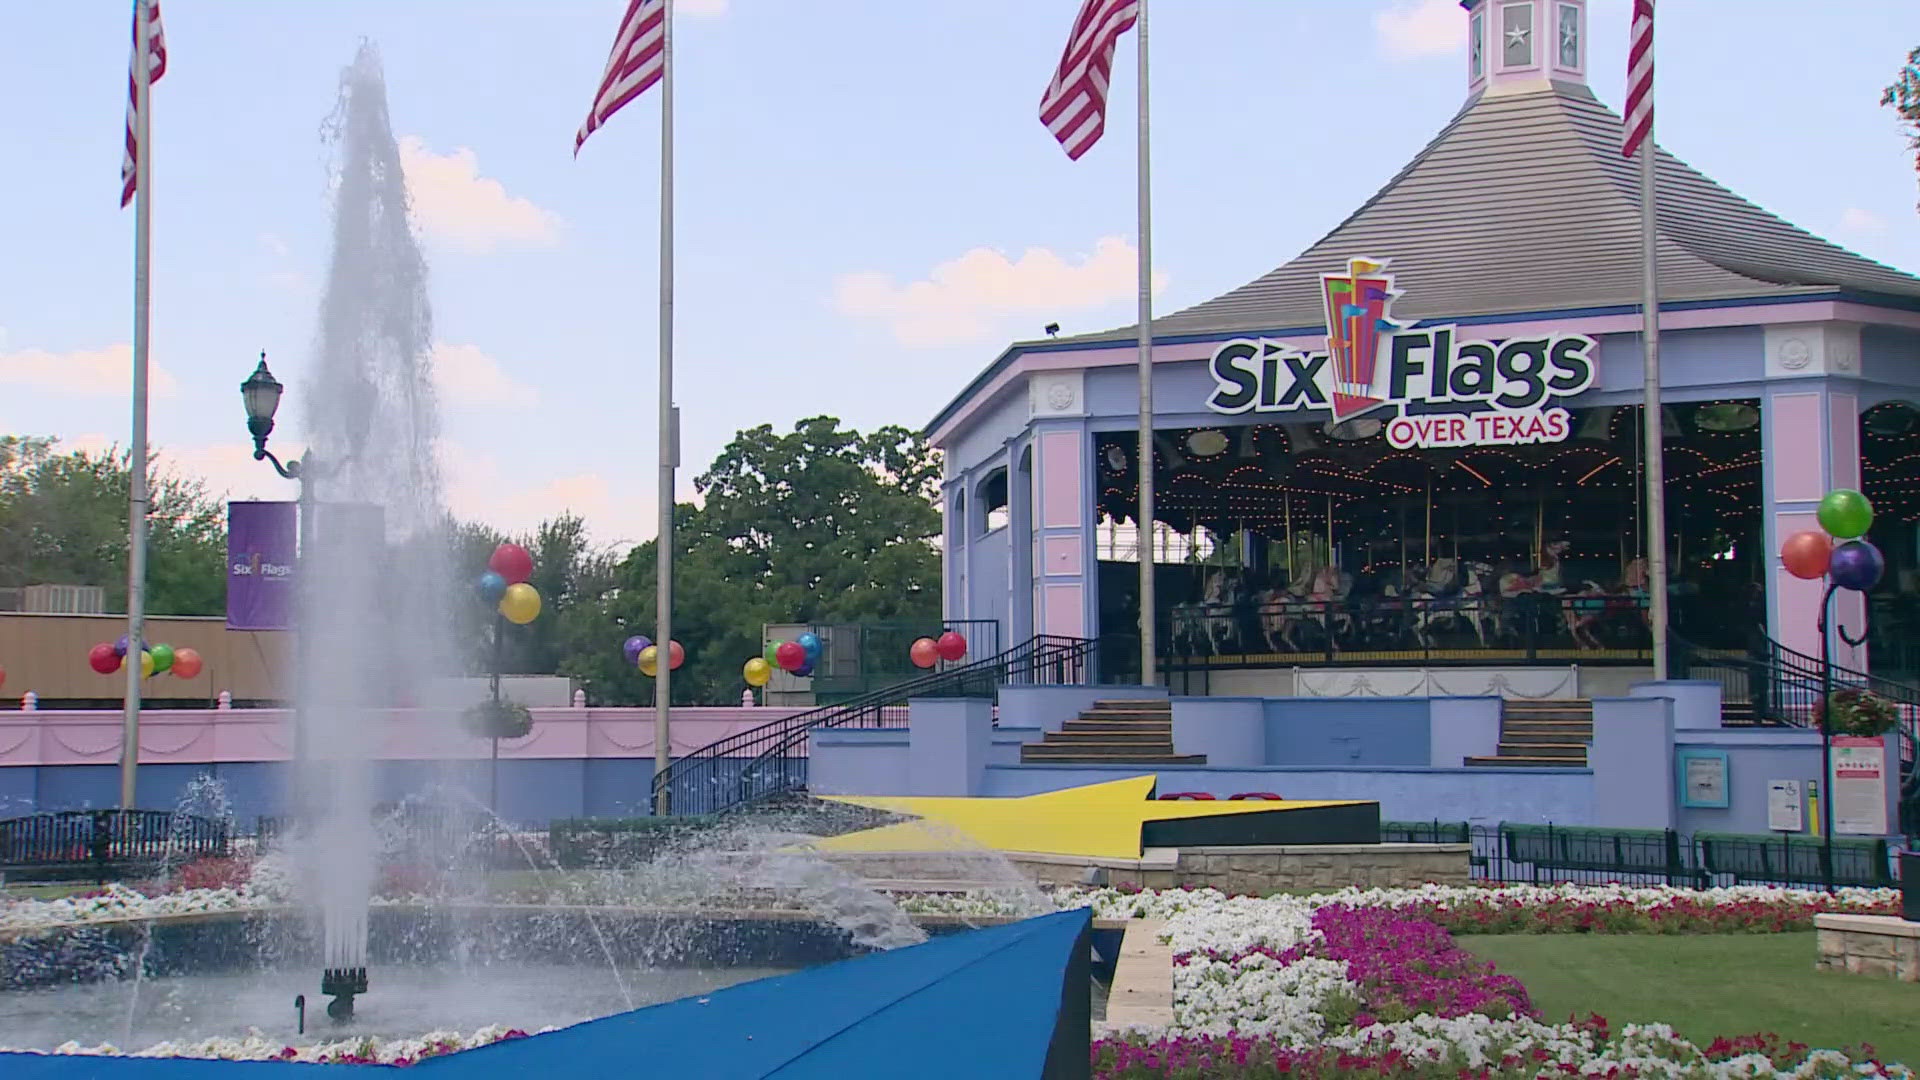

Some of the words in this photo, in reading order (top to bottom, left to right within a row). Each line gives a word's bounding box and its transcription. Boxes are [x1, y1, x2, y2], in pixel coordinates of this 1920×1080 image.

[1212, 341, 1328, 410] Six
[1389, 329, 1591, 408] Flags
[1390, 418, 1467, 444] OVER
[1475, 414, 1565, 440] TEXAS
[233, 563, 253, 575] Six
